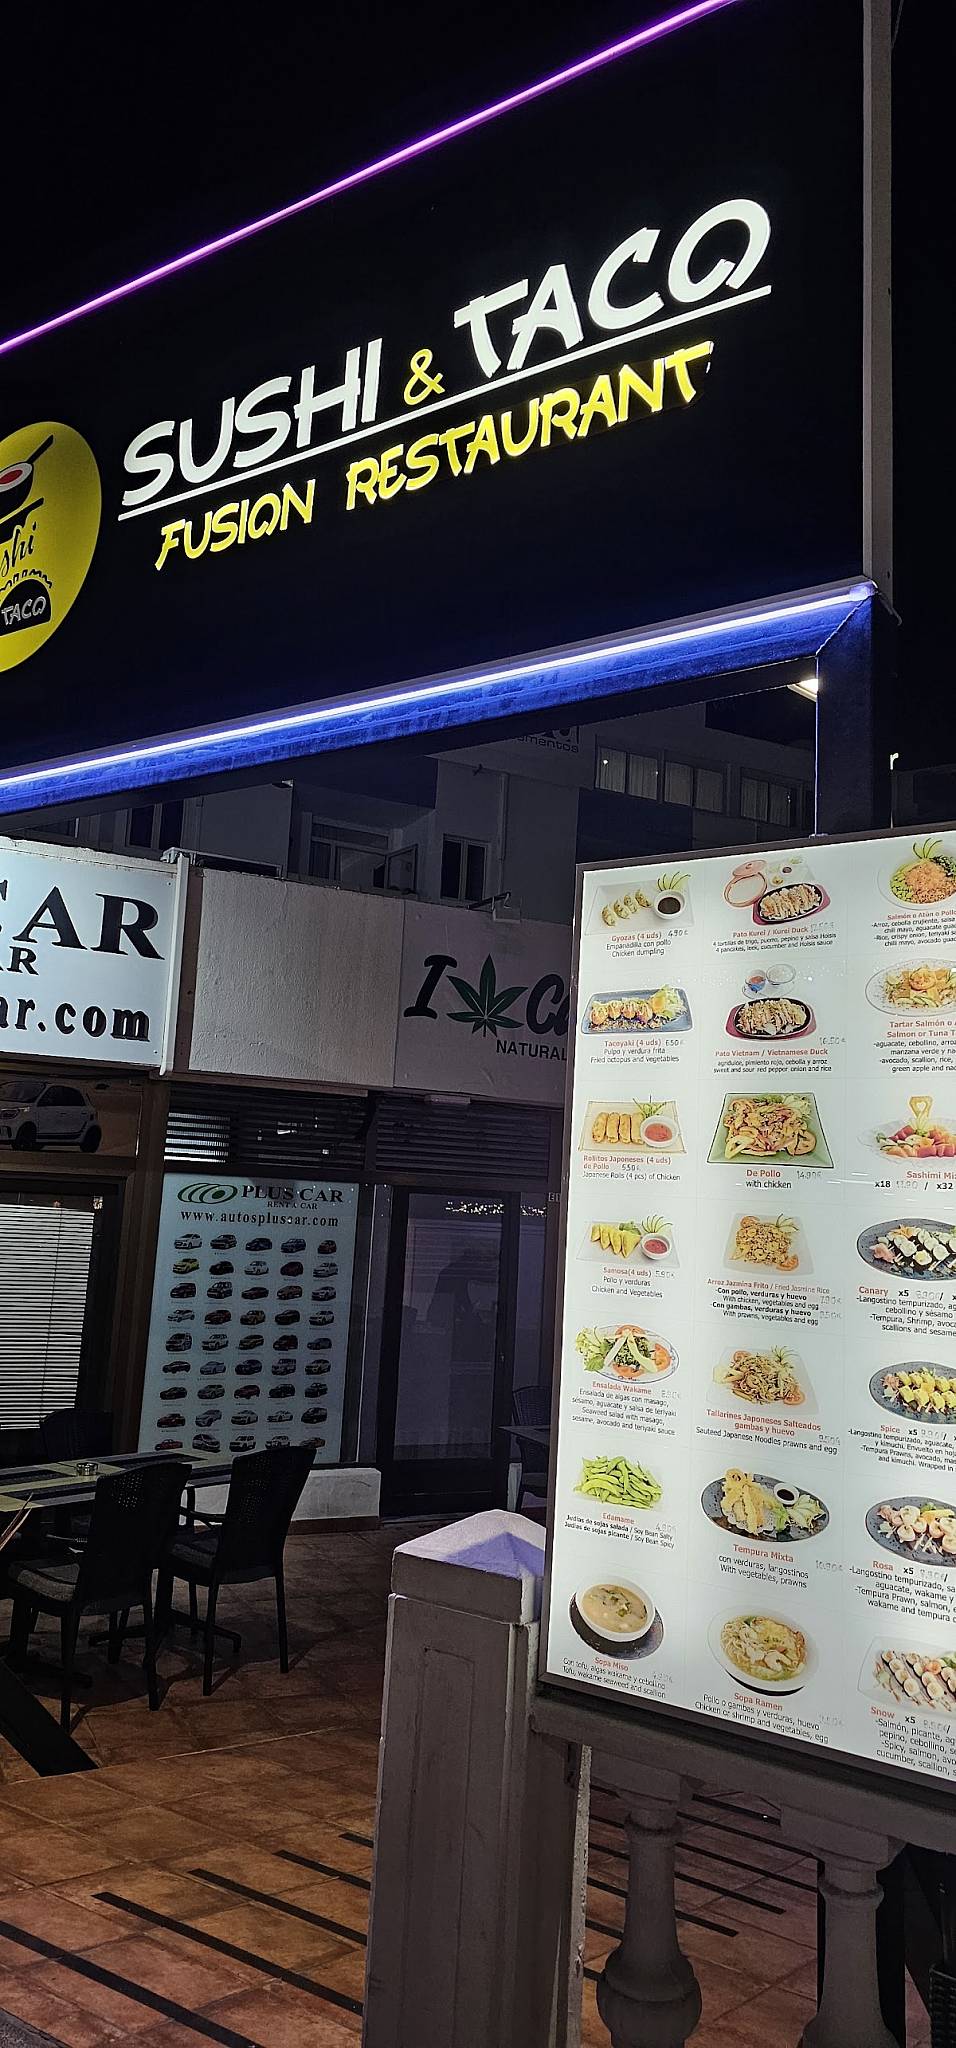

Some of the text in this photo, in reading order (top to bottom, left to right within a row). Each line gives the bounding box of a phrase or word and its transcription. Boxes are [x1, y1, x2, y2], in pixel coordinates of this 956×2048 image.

[122, 198, 771, 505] SUSHI & TACO
[155, 340, 714, 571] FUSION RESTAURANT
[1, 596, 46, 625] TACO
[637, 948, 664, 956] dumpling
[404, 954, 458, 1020] I
[496, 1039, 569, 1062] NATURAL
[646, 1055, 679, 1063] vegetables
[656, 1157, 671, 1165] uds)
[907, 1171, 941, 1179] Sashimi
[746, 1180, 791, 1188] with chicken
[241, 1185, 343, 1203] PLUS CAR
[267, 1201, 290, 1209] RENT
[630, 1289, 662, 1298] Vegetables
[750, 1291, 779, 1299] verduras
[859, 1286, 888, 1296] Canary
[762, 1299, 793, 1307] vegetables
[899, 1299, 945, 1310] tempurizado,
[755, 1306, 783, 1314] verduras
[886, 1307, 916, 1315] cebollino
[761, 1314, 793, 1322] vegetables
[907, 1317, 935, 1326] Shrimp,
[882, 1324, 911, 1332] scallions
[593, 1381, 652, 1394] Ensalada Wakame
[582, 1407, 607, 1416] Seaweed
[597, 1419, 620, 1427] avocado
[707, 1409, 821, 1431] Tallarines Japoneses Salteados
[735, 1422, 794, 1436] gambas huevo
[880, 1425, 900, 1433] Spice
[723, 1430, 752, 1442] Japanese
[754, 1435, 780, 1445] Noodles
[782, 1441, 807, 1449] prawns
[824, 1446, 837, 1455] egg
[918, 1461, 945, 1471] Wrapped
[602, 1513, 635, 1524] Edamame
[610, 1523, 628, 1531] salada
[733, 1544, 794, 1562] Tempura Mixta
[719, 1555, 765, 1571] con verduras,
[873, 1561, 893, 1571] Rosa
[720, 1564, 807, 1588] With prawns
[850, 1566, 944, 1591] -Langostino tempurizado,
[876, 1582, 947, 1601] aguacate, wakame
[892, 1593, 950, 1613] Prawn, salmon,
[868, 1600, 950, 1621] wakame and tempura
[594, 1657, 628, 1671] Sopa Miso
[734, 1692, 782, 1711] Sopa Ramen
[704, 1694, 720, 1704] Pollo
[728, 1702, 754, 1713] gambas
[798, 1719, 819, 1730] huevo
[871, 1706, 895, 1719] Snow
[695, 1702, 828, 1744] Chicken shrimp egg
[912, 1728, 943, 1742] picante,
[910, 1738, 947, 1754] cebollino,
[877, 1749, 916, 1766] cucumber,
[909, 1748, 939, 1762] salmon,
